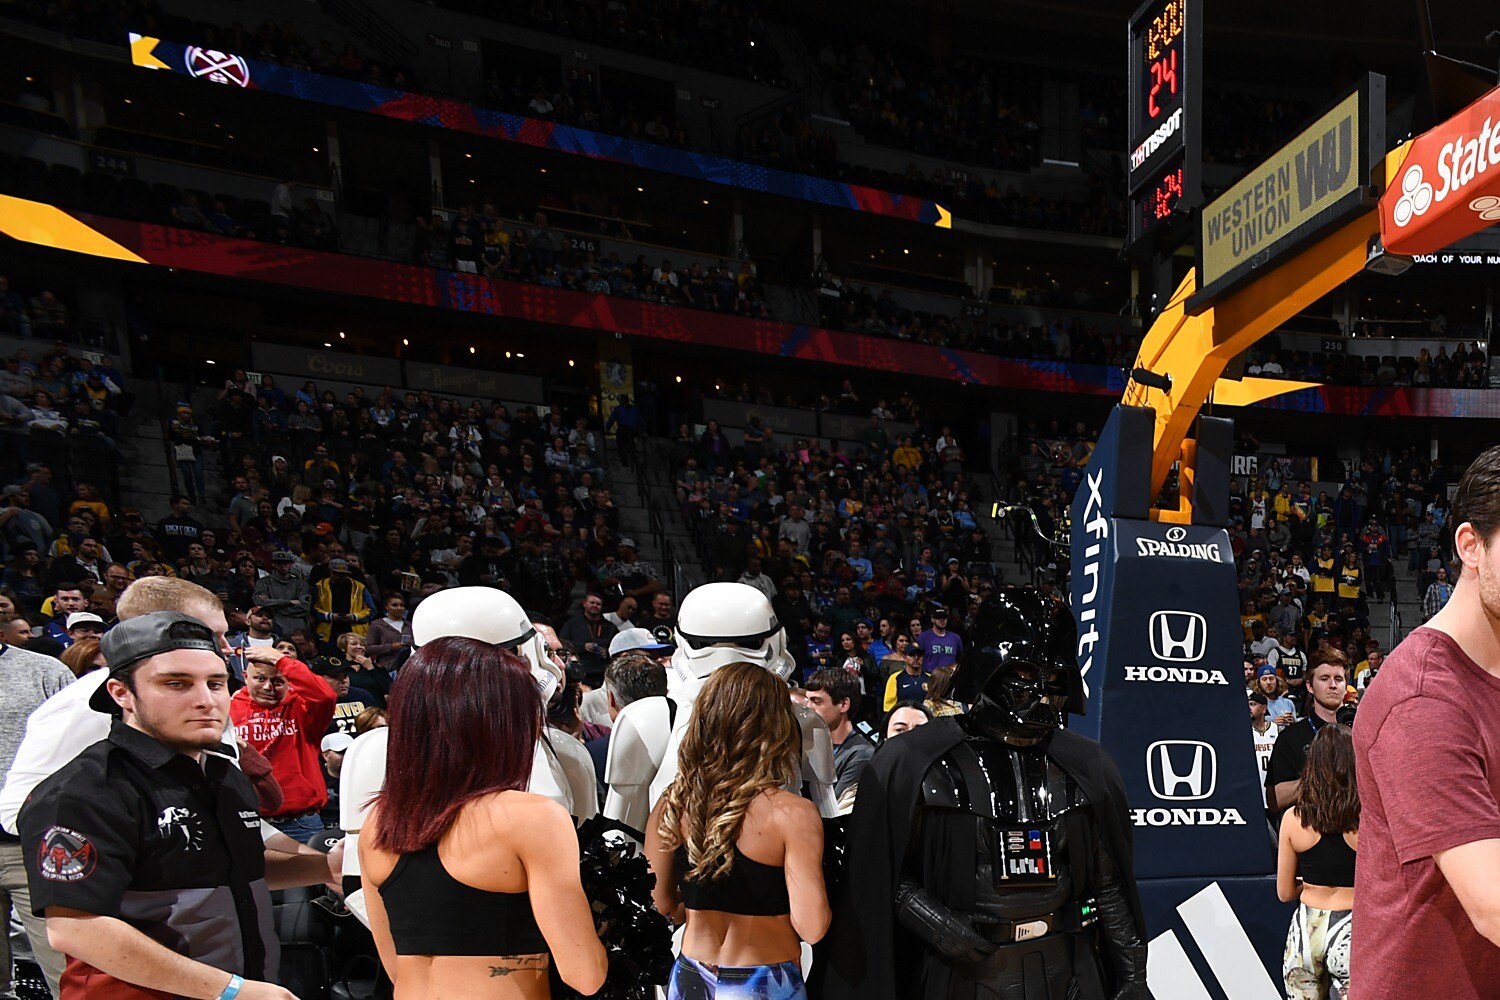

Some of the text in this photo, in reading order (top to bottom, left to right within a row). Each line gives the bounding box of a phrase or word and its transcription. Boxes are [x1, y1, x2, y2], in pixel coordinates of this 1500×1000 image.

[1149, 49, 1177, 118] 24
[1143, 107, 1183, 154] TISSOT
[1207, 115, 1352, 246] WESTERN WU
[1232, 194, 1290, 258] UNION
[570, 239, 595, 251] 246
[1412, 255, 1438, 265] OACH
[1442, 255, 1453, 264] OF
[1459, 256, 1482, 265] YOUR
[1325, 341, 1342, 350] 250
[306, 353, 365, 378] Coors
[246, 374, 261, 385] XIT
[432, 367, 478, 389] Banquet
[745, 408, 789, 428] Cors
[1136, 537, 1223, 563] SPALDING
[1124, 666, 1229, 685] HONDA
[1289, 666, 1298, 676] 27
[333, 702, 365, 718] NVER
[337, 719, 357, 734] 27
[1127, 808, 1247, 826] HONDA
